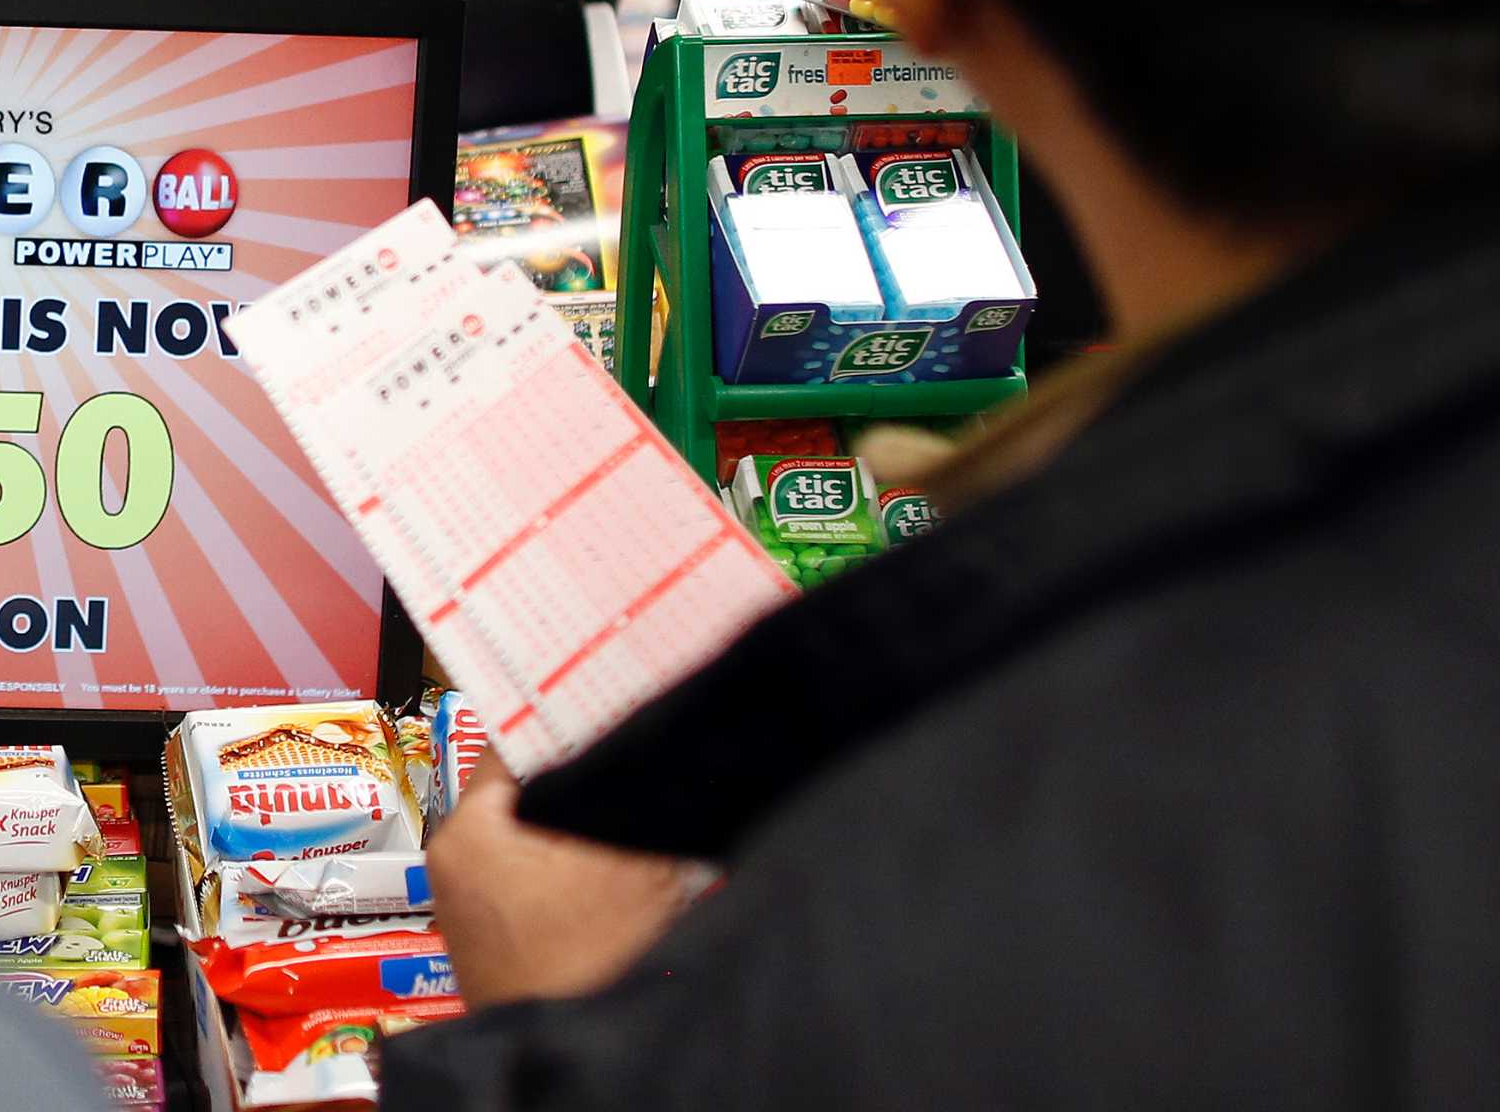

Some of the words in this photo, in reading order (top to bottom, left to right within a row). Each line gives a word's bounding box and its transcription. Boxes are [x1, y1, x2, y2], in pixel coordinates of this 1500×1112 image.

[736, 56, 773, 78] tic
[787, 64, 828, 84] fres
[725, 74, 771, 93] tac
[767, 168, 814, 187] tic
[899, 166, 945, 184] tic
[157, 172, 235, 212] BALL
[891, 184, 948, 200] tac
[1, 296, 68, 354] IS
[771, 322, 802, 332] tac
[780, 314, 805, 325] tic
[871, 334, 914, 353] tic
[853, 350, 910, 366] tac
[795, 474, 843, 494] tic
[786, 491, 845, 510] tac
[10, 807, 61, 823] Knusper
[11, 821, 57, 838] Snack
[0, 872, 41, 892] Knusper
[0, 886, 38, 910] Snack
